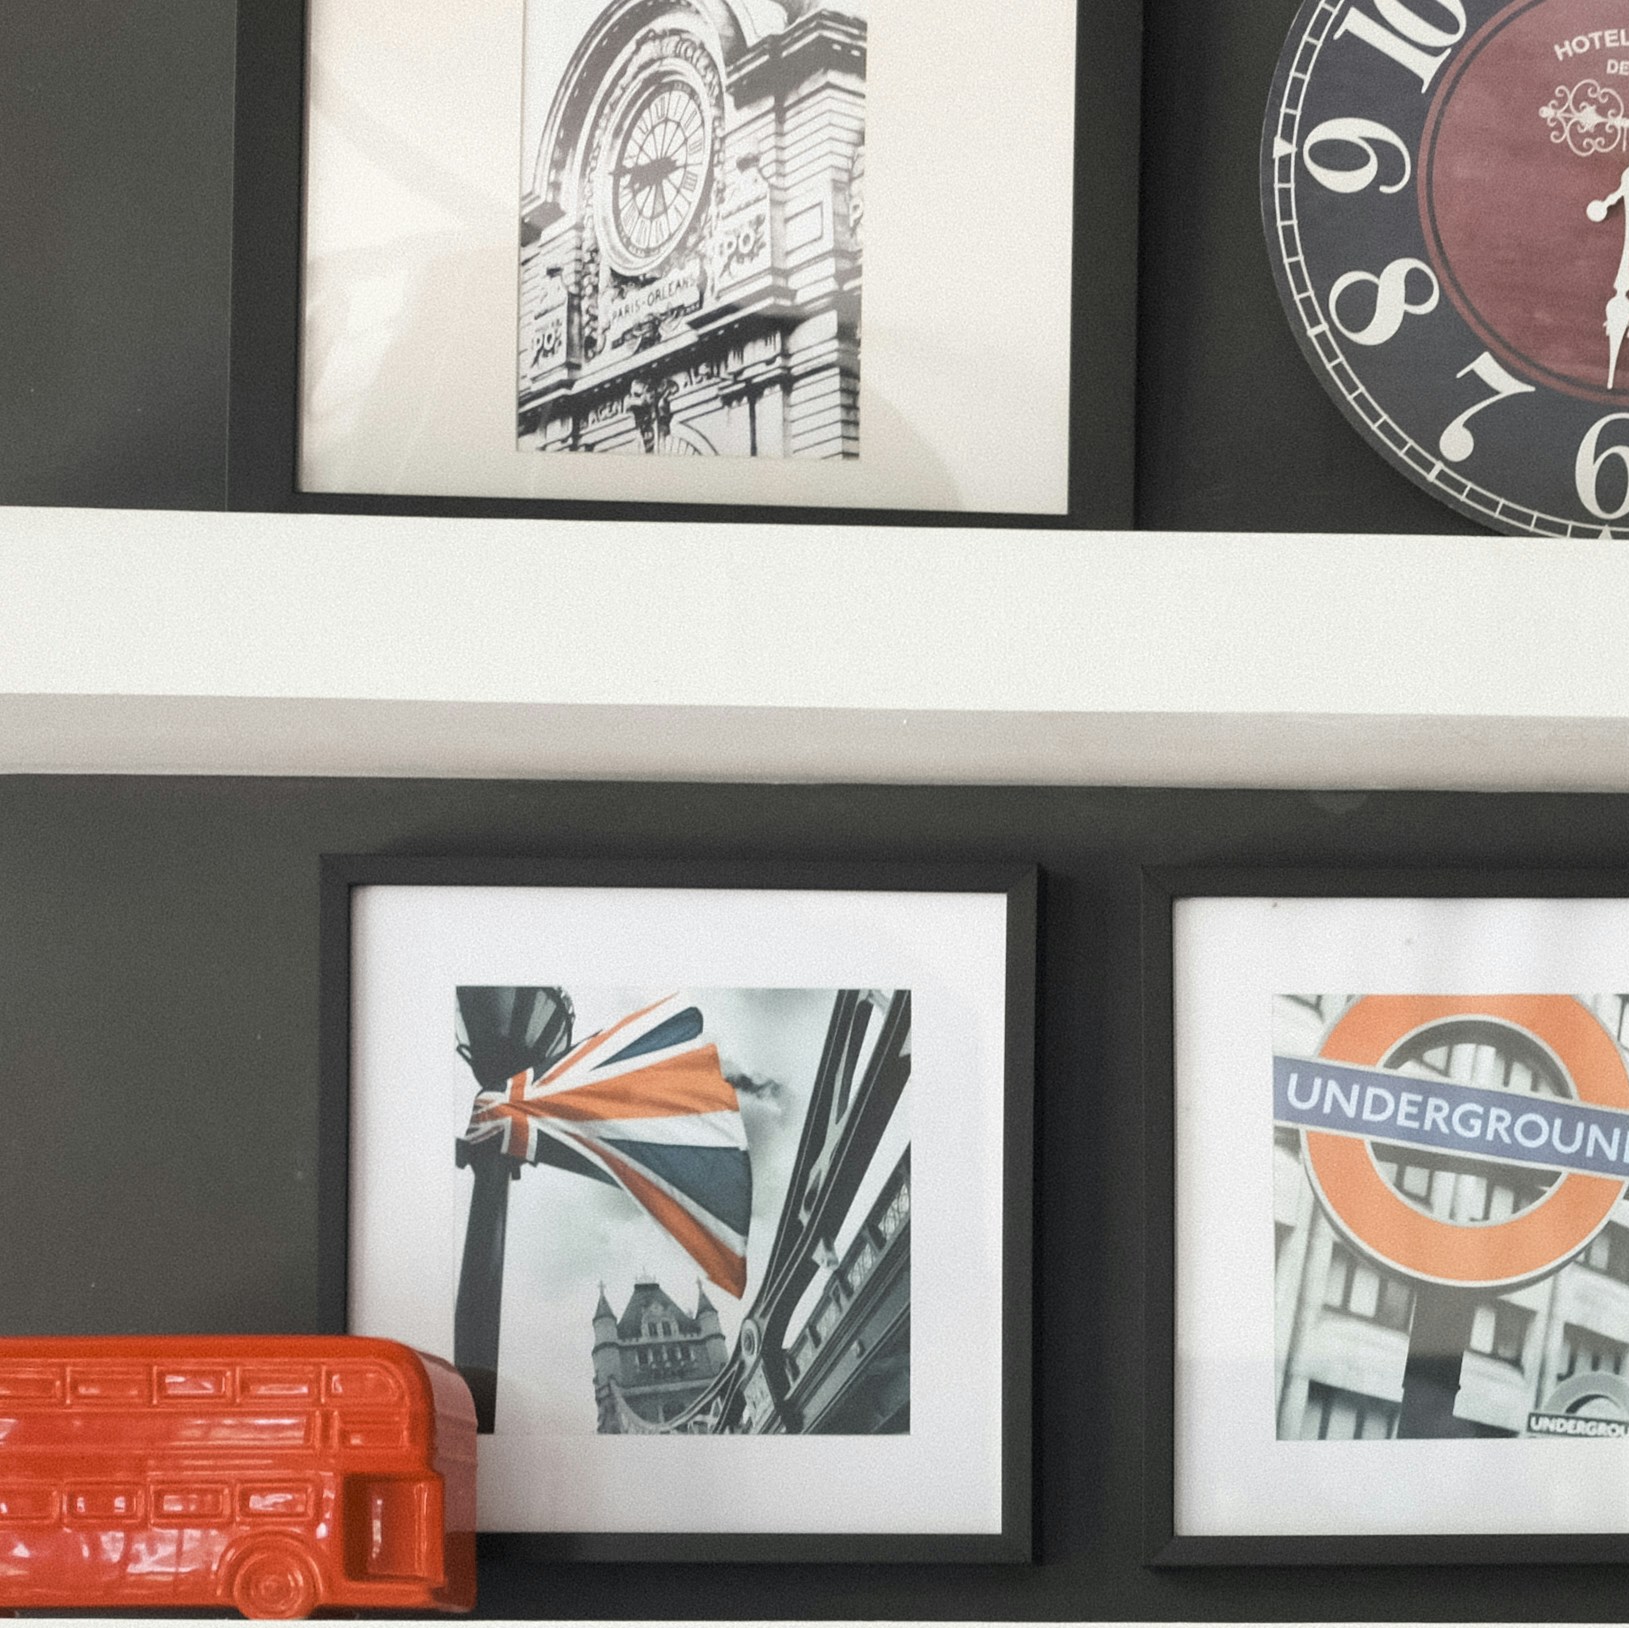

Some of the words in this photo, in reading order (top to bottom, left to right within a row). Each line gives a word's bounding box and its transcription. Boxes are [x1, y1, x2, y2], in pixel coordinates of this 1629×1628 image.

[1303, 118, 1411, 193] 9
[1329, 257, 1440, 346] 8
[1439, 351, 1536, 463] 7
